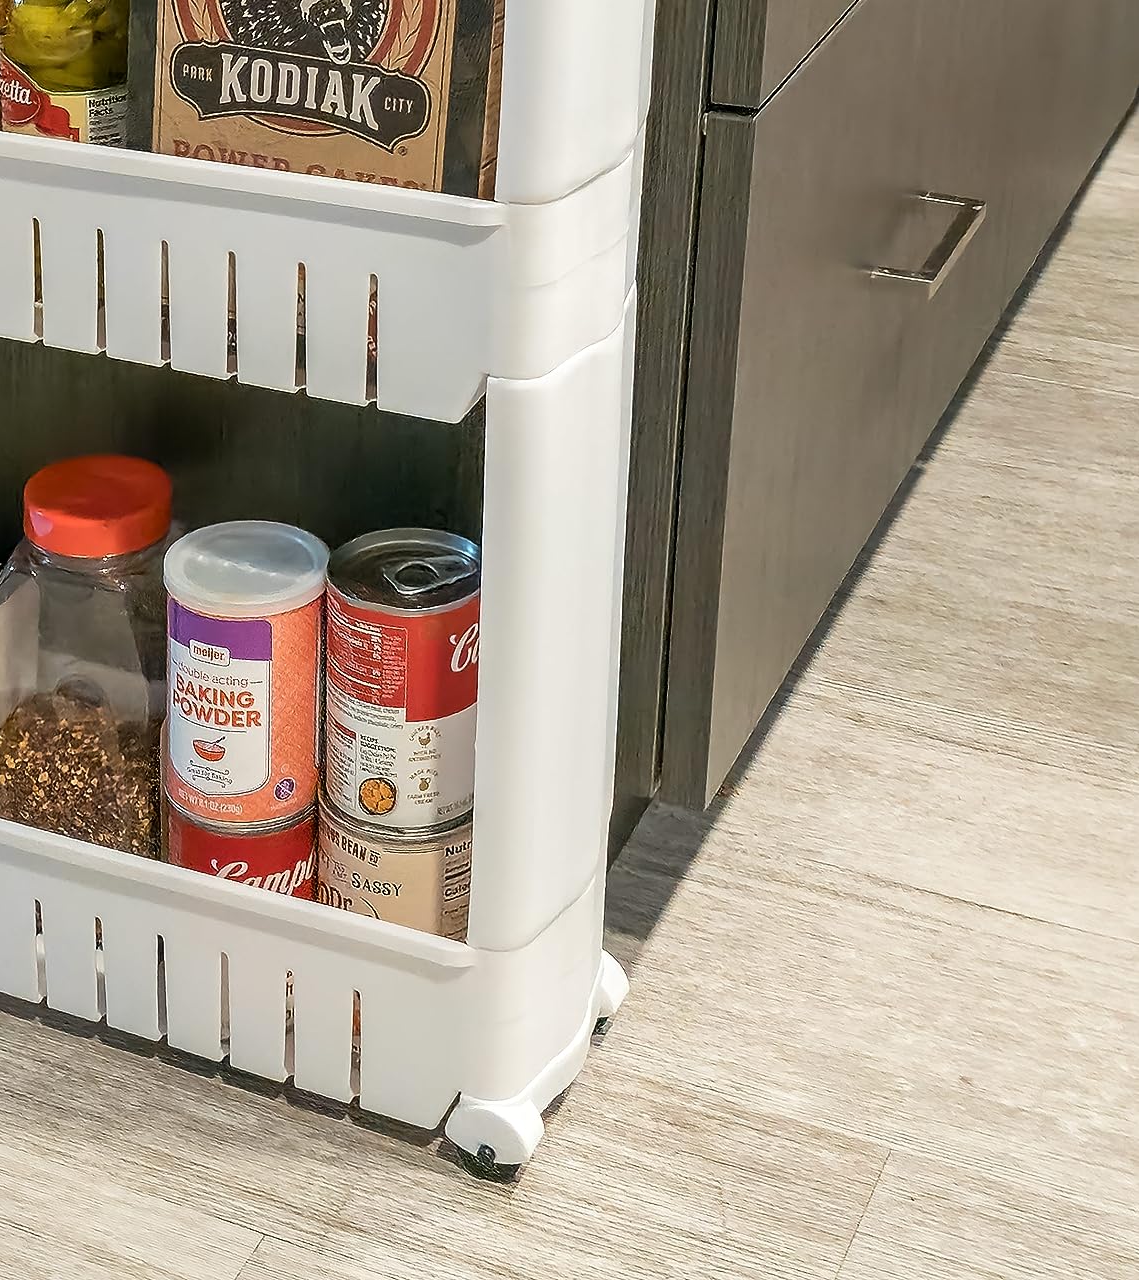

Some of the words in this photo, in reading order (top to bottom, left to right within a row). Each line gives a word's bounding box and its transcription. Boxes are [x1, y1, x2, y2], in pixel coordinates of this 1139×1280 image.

[182, 63, 213, 82] PARK
[219, 52, 380, 131] KODIAK
[383, 96, 414, 115] CITY
[89, 108, 114, 118] Facts
[193, 645, 224, 661] meijer
[178, 662, 209, 681] double
[212, 675, 248, 687] acting
[176, 672, 254, 709] BAKING
[173, 689, 261, 727] POWDER
[341, 833, 367, 862] BEAN
[351, 872, 403, 897] SASSY
